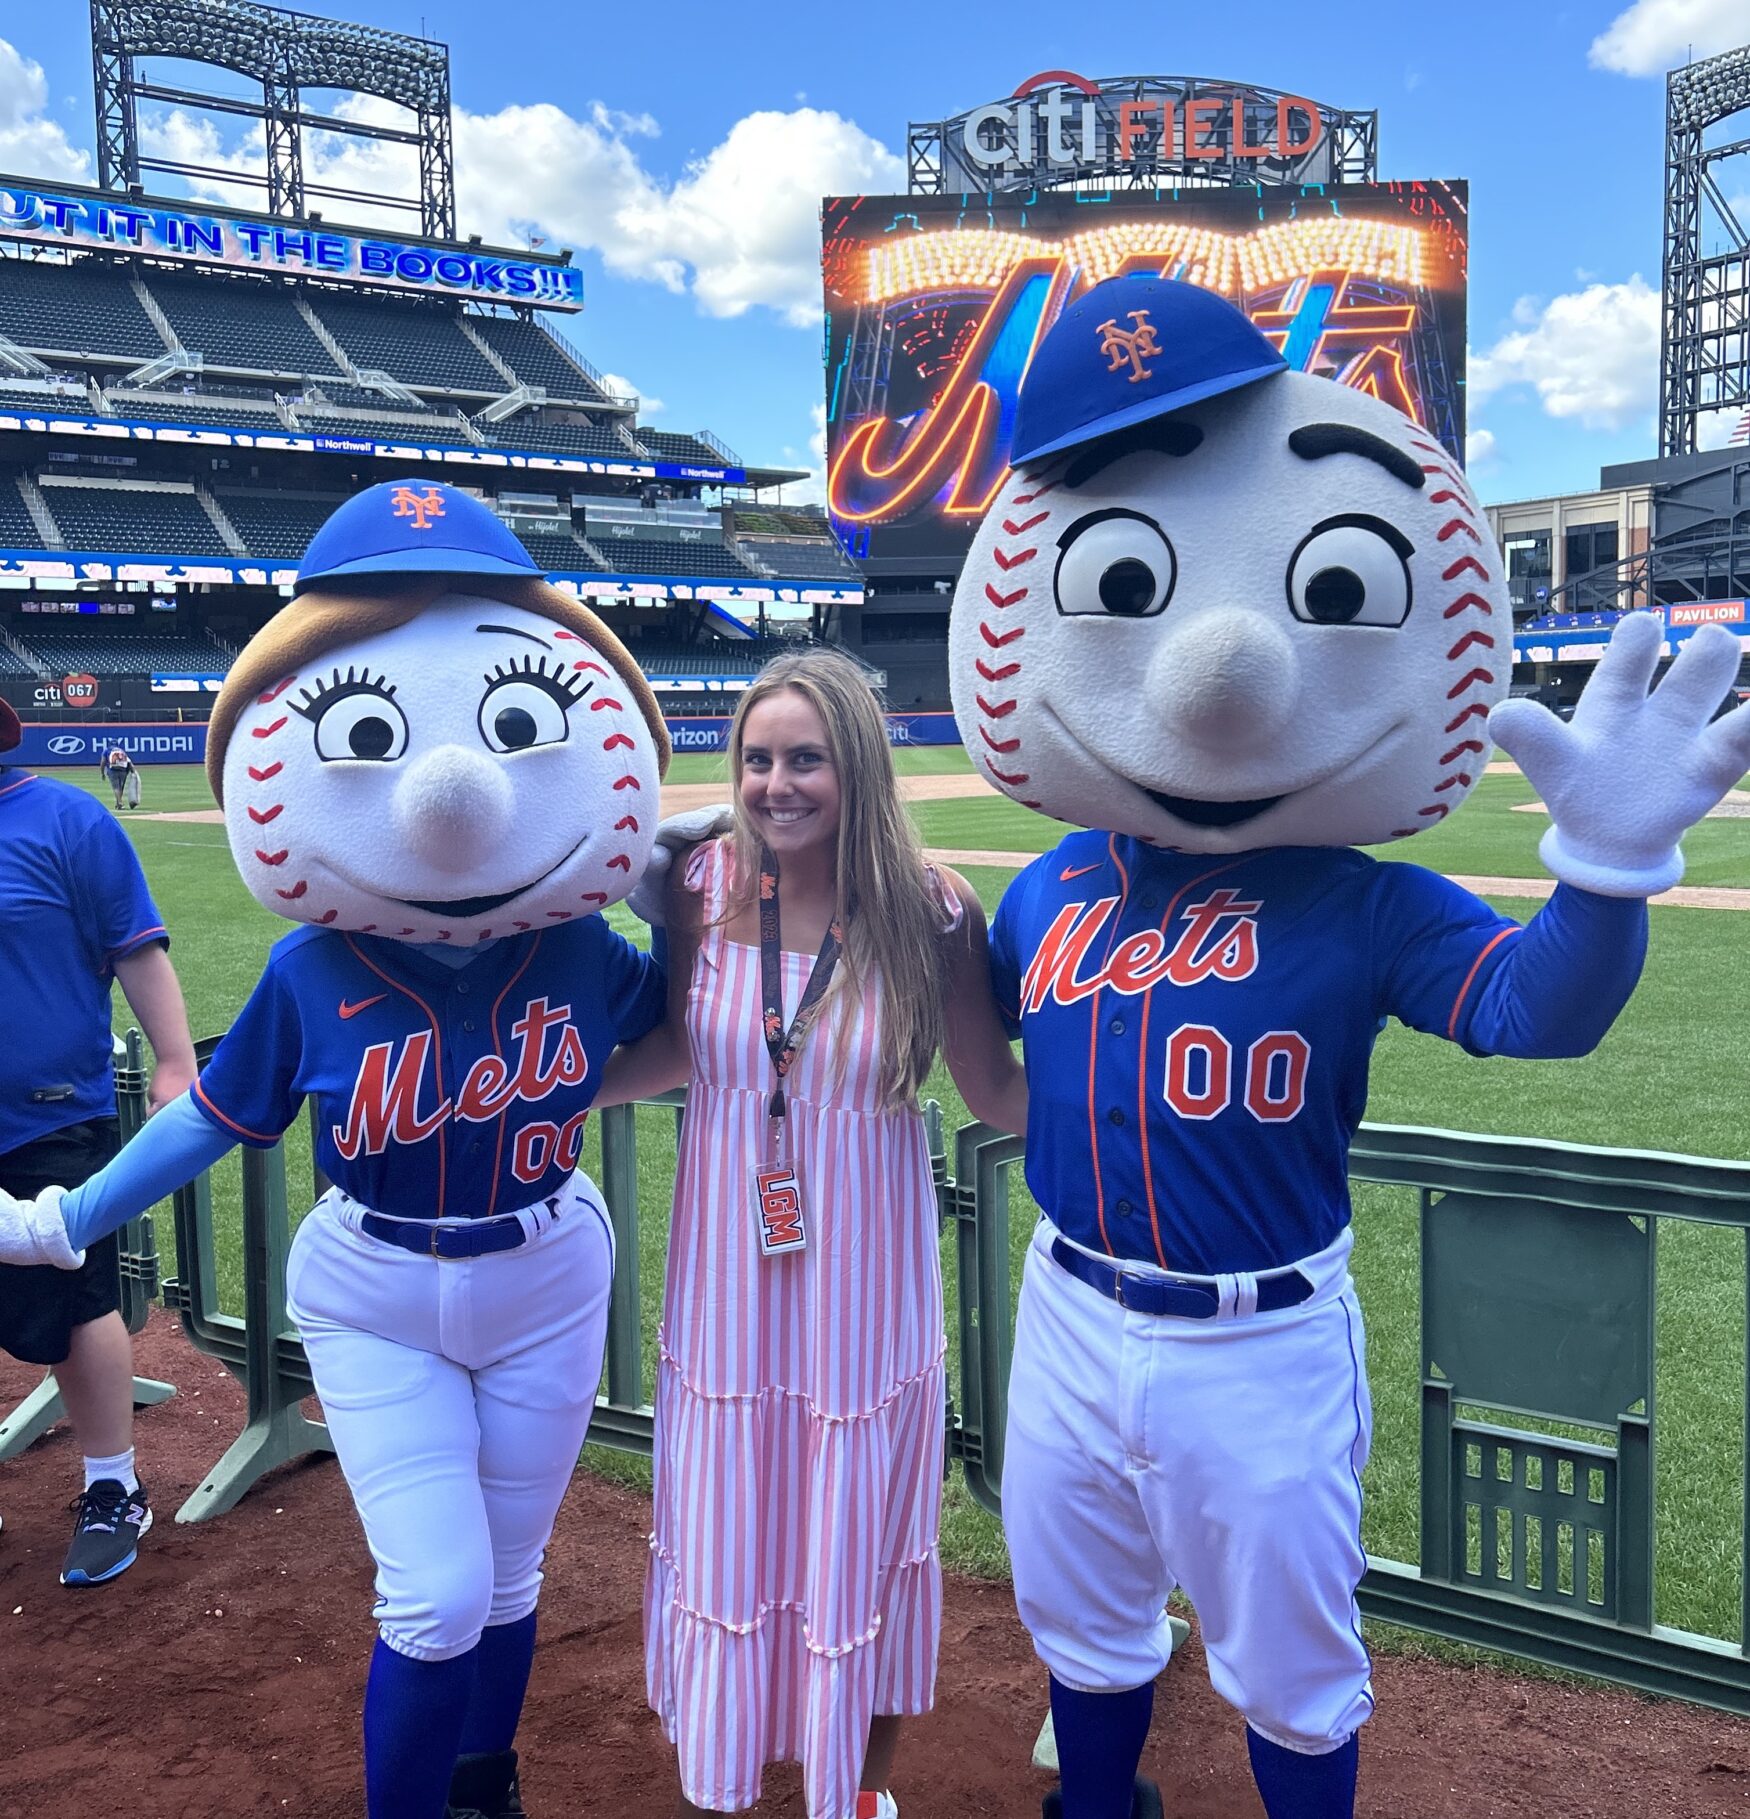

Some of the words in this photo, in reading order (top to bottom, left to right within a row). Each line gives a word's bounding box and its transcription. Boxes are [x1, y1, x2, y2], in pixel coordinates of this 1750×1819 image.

[963, 86, 1097, 165] citi
[1119, 97, 1322, 162] FIELD
[98, 208, 152, 243] IT
[167, 219, 224, 255] IN
[237, 226, 346, 271] THE
[359, 244, 576, 299] BOOKS!!!
[324, 439, 373, 452] Northwell
[688, 468, 725, 479] Northwell
[1674, 607, 1740, 622] PAVILION
[34, 685, 61, 700] citi
[67, 684, 93, 697] 067
[670, 726, 719, 746] rizon
[1020, 889, 1264, 1020] Mets
[333, 996, 589, 1161] Mets
[1163, 1023, 1312, 1123] 00
[757, 1168, 804, 1247] LGM
